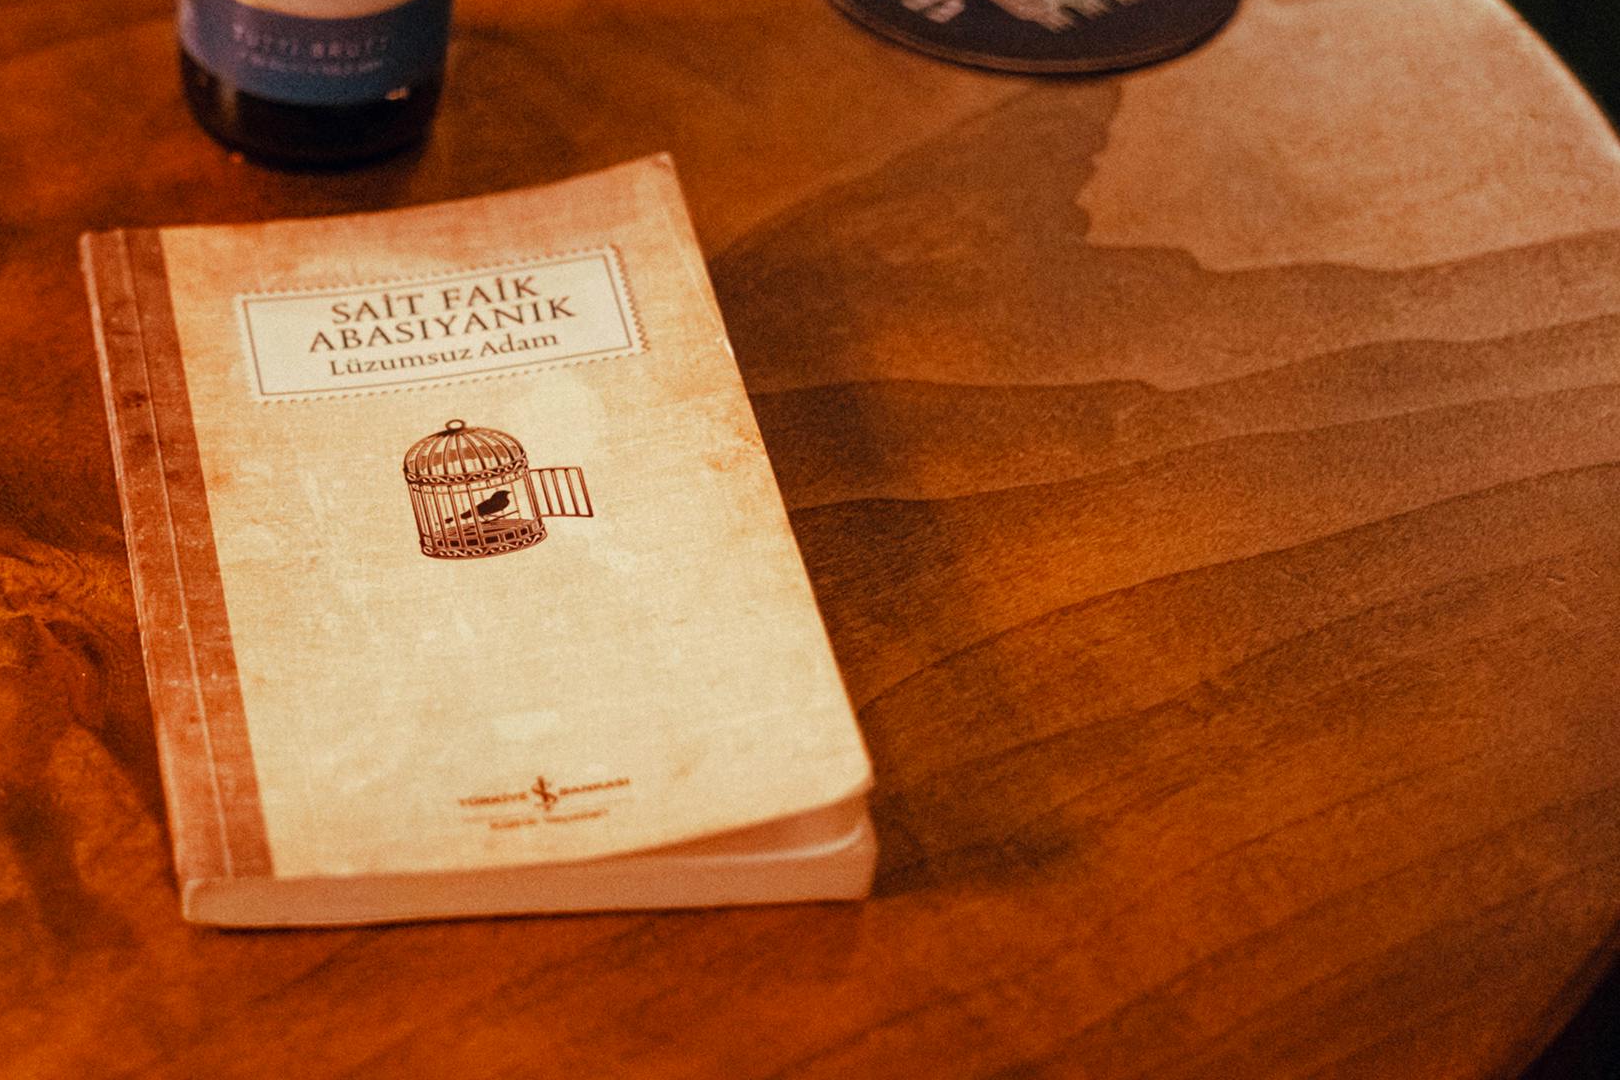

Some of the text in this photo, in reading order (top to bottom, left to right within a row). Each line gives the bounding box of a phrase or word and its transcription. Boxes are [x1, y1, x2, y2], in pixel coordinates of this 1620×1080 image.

[309, 296, 576, 353] ABASIYANIK
[329, 333, 559, 376] Lüzumsuz Adam
